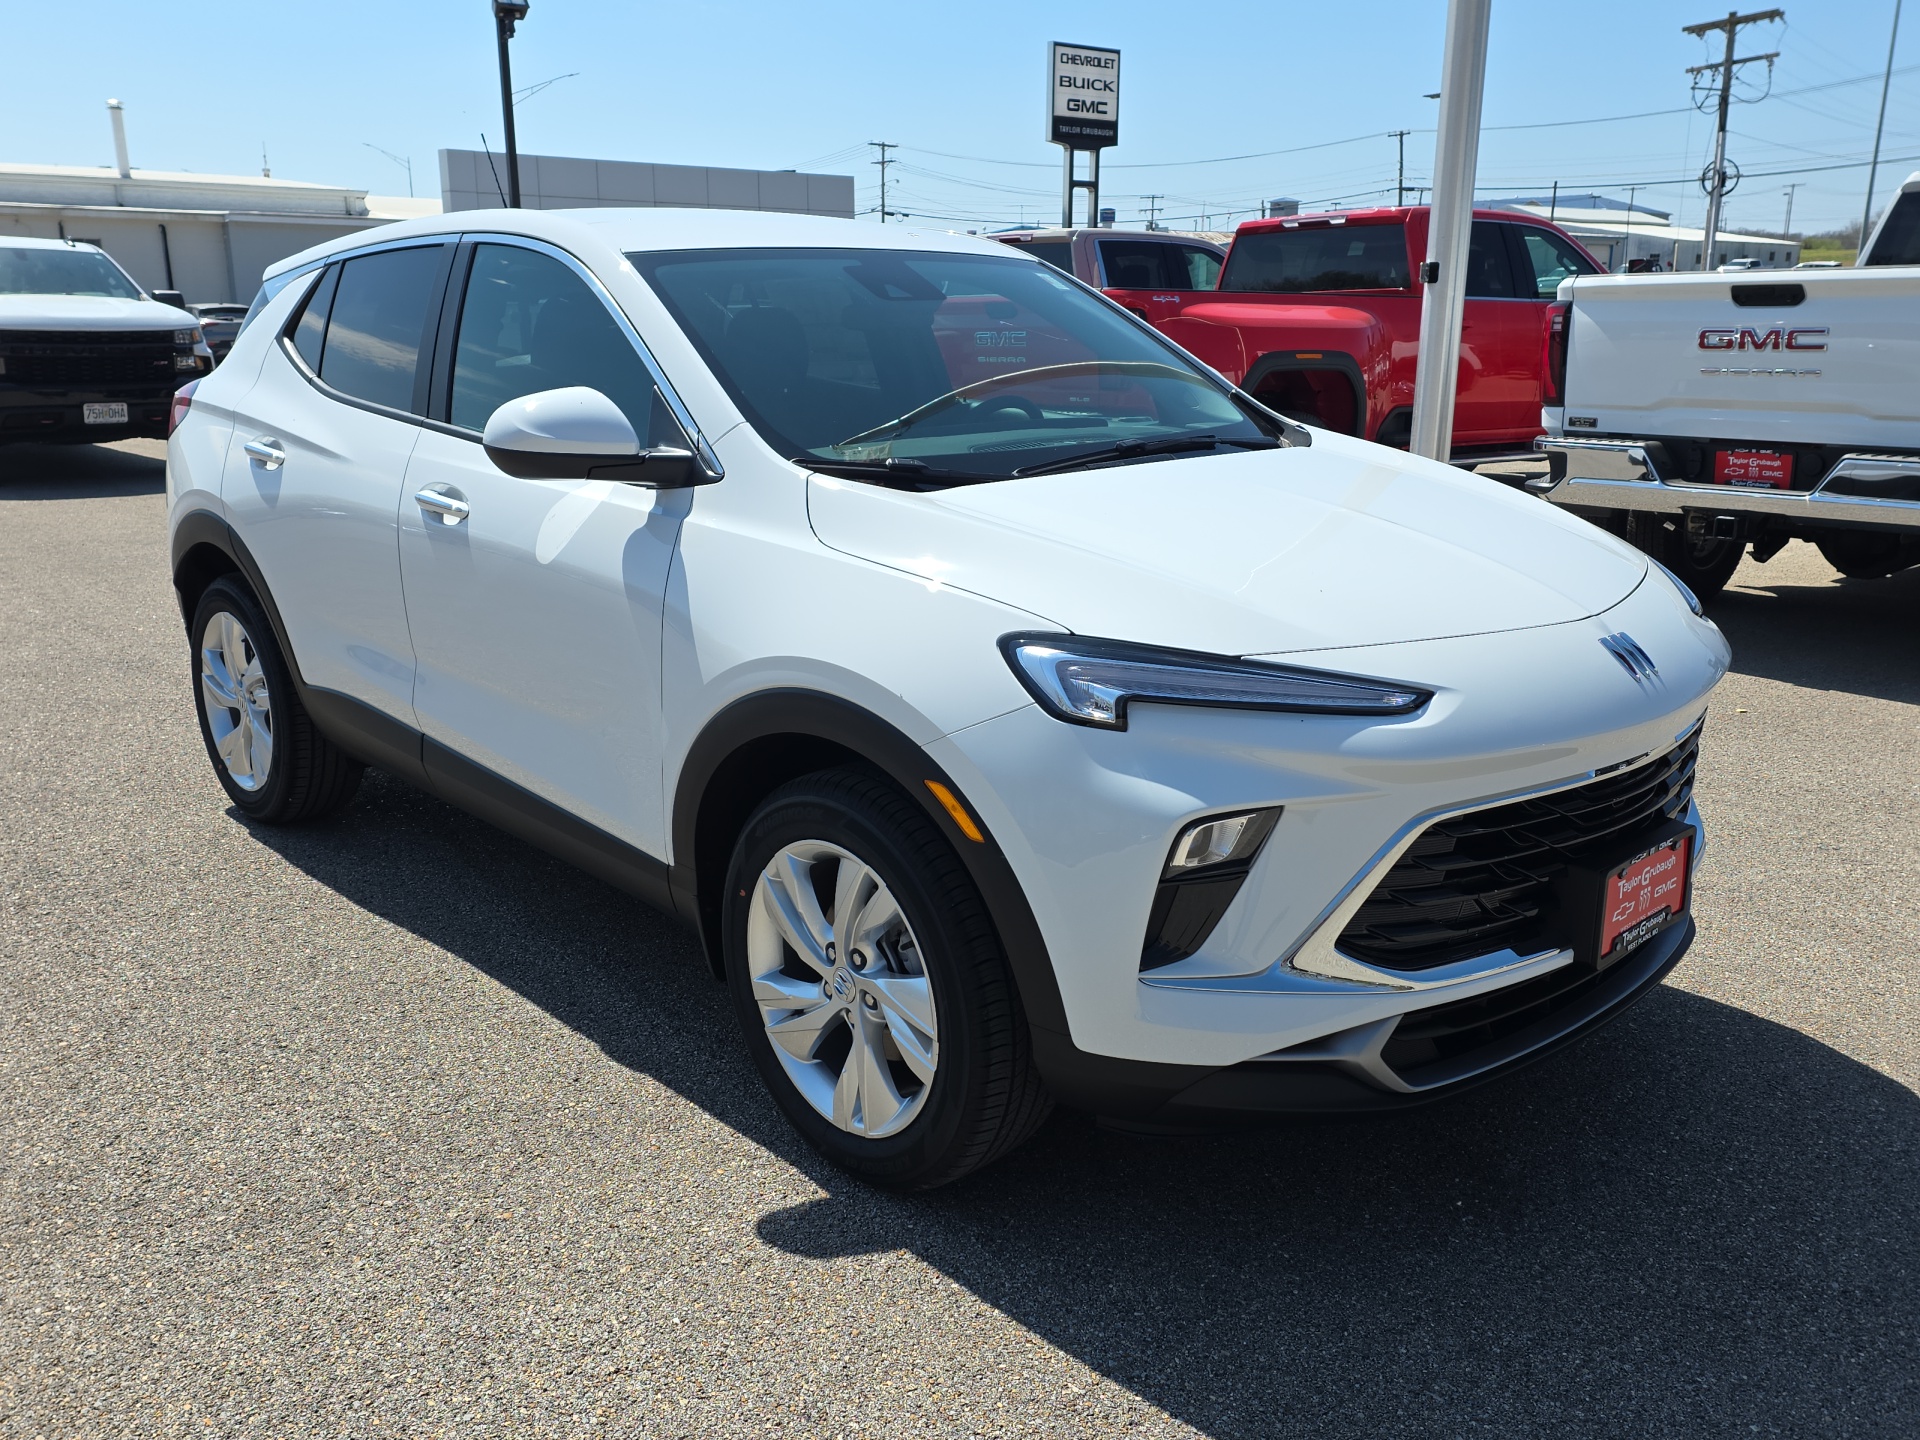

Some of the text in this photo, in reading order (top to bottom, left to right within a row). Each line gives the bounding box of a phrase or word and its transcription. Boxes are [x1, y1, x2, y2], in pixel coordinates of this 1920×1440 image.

[1060, 53, 1116, 69] CHEVROLET
[1059, 75, 1115, 93] BUICK
[1067, 98, 1108, 114] GMC
[1059, 125, 1114, 137] TAYLOR GRUBAUGH
[974, 331, 1027, 347] GMC
[1697, 327, 1830, 351] GMC
[1728, 456, 1782, 467] Taylor Grubaugh
[1762, 470, 1784, 478] GMC
[1618, 855, 1676, 899] Taylor Grubaugh
[1654, 877, 1677, 898] GMC
[1623, 911, 1666, 947] Taylor Grubaugh
